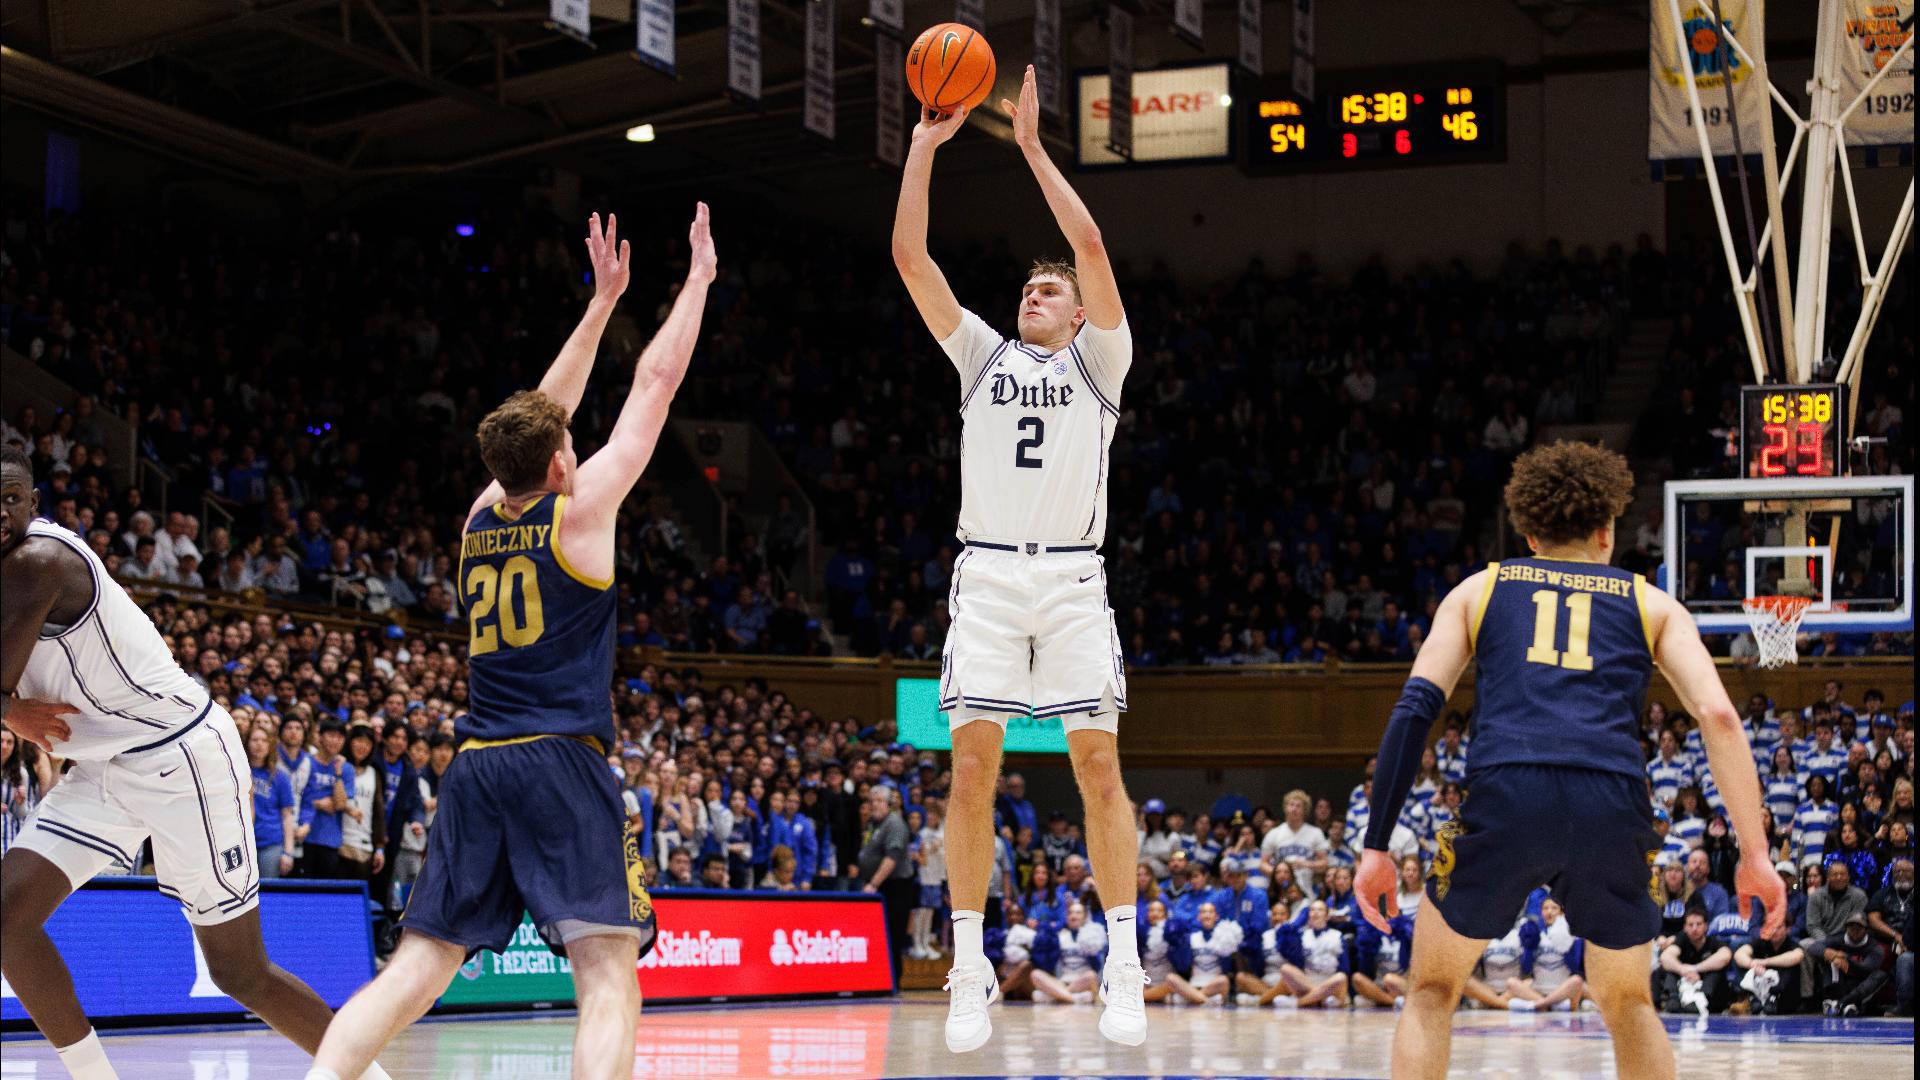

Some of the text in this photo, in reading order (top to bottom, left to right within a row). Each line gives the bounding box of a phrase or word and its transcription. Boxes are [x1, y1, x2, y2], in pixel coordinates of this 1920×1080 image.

[1342, 91, 1407, 124] 15:38
[1865, 92, 1914, 114] 1992
[1269, 124, 1305, 152] 54
[1395, 130, 1411, 154] 6
[1442, 111, 1477, 141] 46
[1343, 133, 1357, 157] 3
[990, 373, 1074, 408] Duke
[1762, 394, 1831, 424] 15:38
[1015, 416, 1045, 469] 2
[1761, 424, 1823, 475] 23
[464, 524, 550, 559] ONIECZNY
[1499, 564, 1633, 598] SHREWSBERRY
[467, 554, 545, 657] 20
[1526, 589, 1594, 671] 11
[492, 951, 557, 975] FREIGHT
